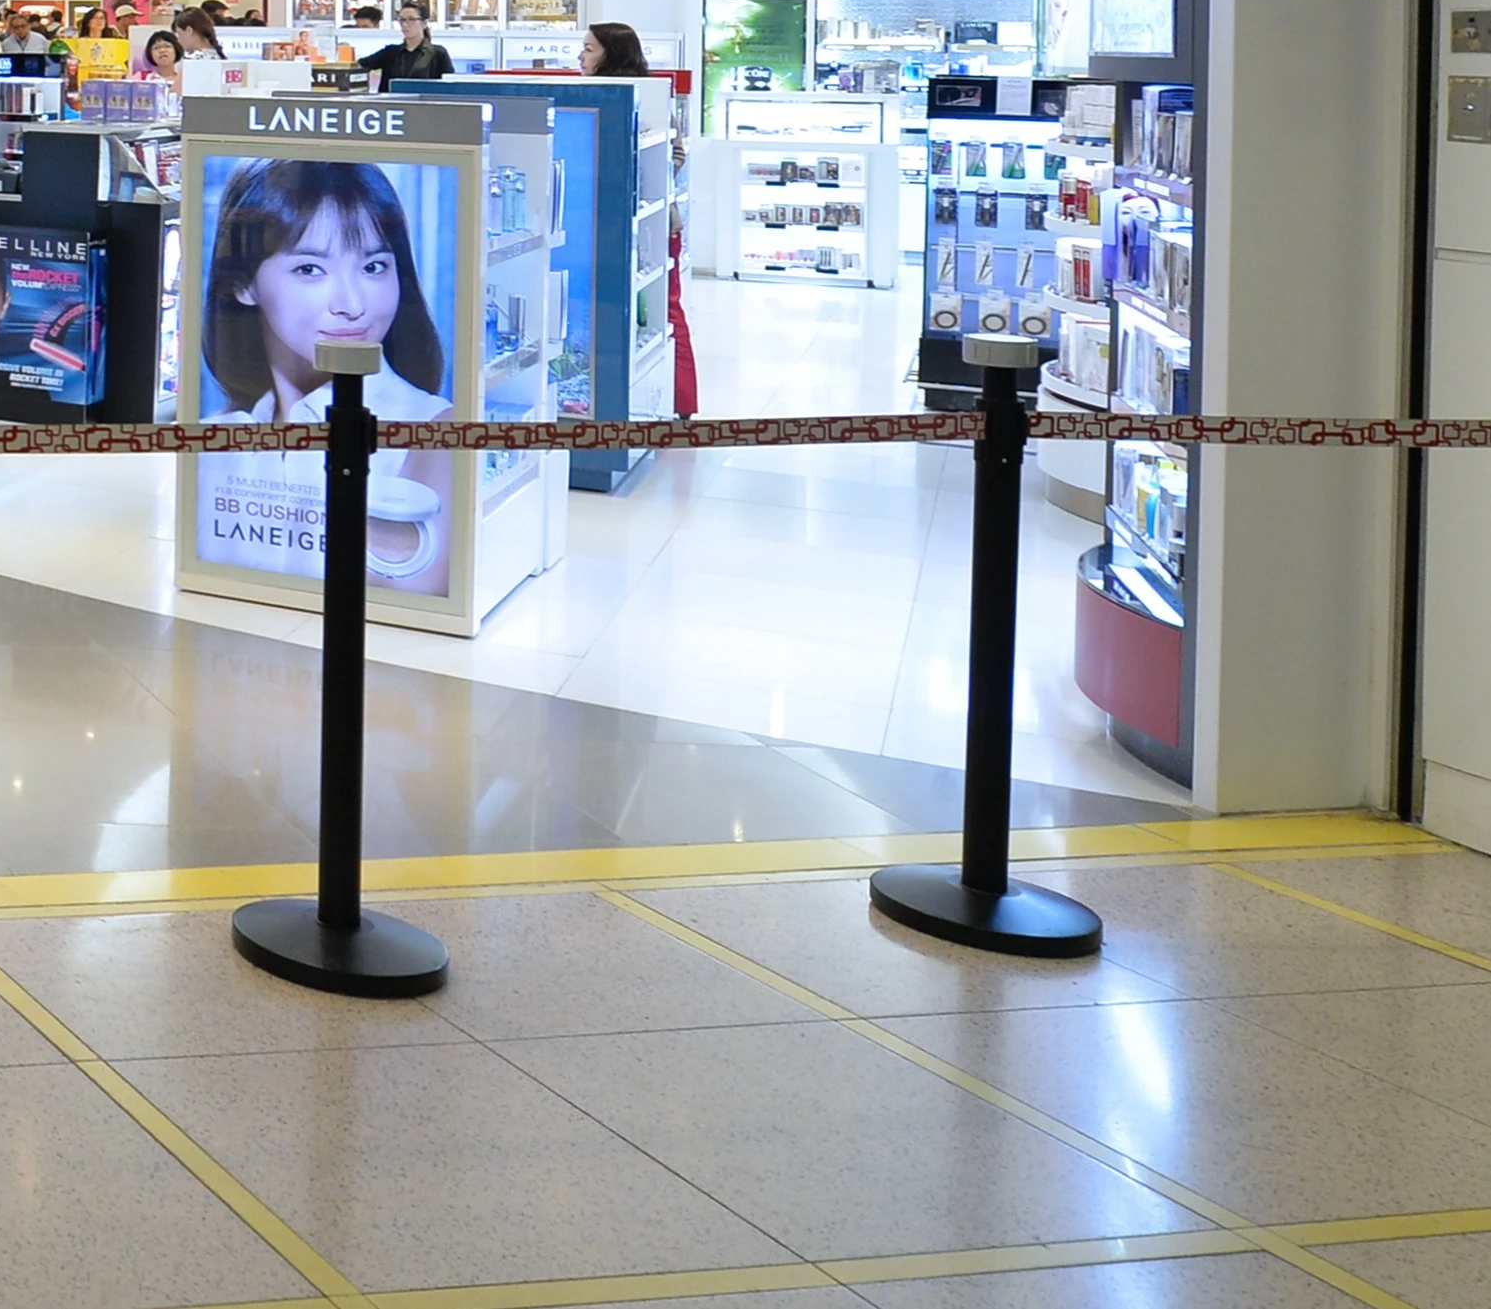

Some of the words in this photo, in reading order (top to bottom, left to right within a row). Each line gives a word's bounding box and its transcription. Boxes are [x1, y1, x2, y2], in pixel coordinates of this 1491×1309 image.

[523, 45, 571, 55] MARC
[249, 105, 406, 137] LANEIGE
[57, 253, 86, 262] YORK
[215, 497, 240, 514] BB
